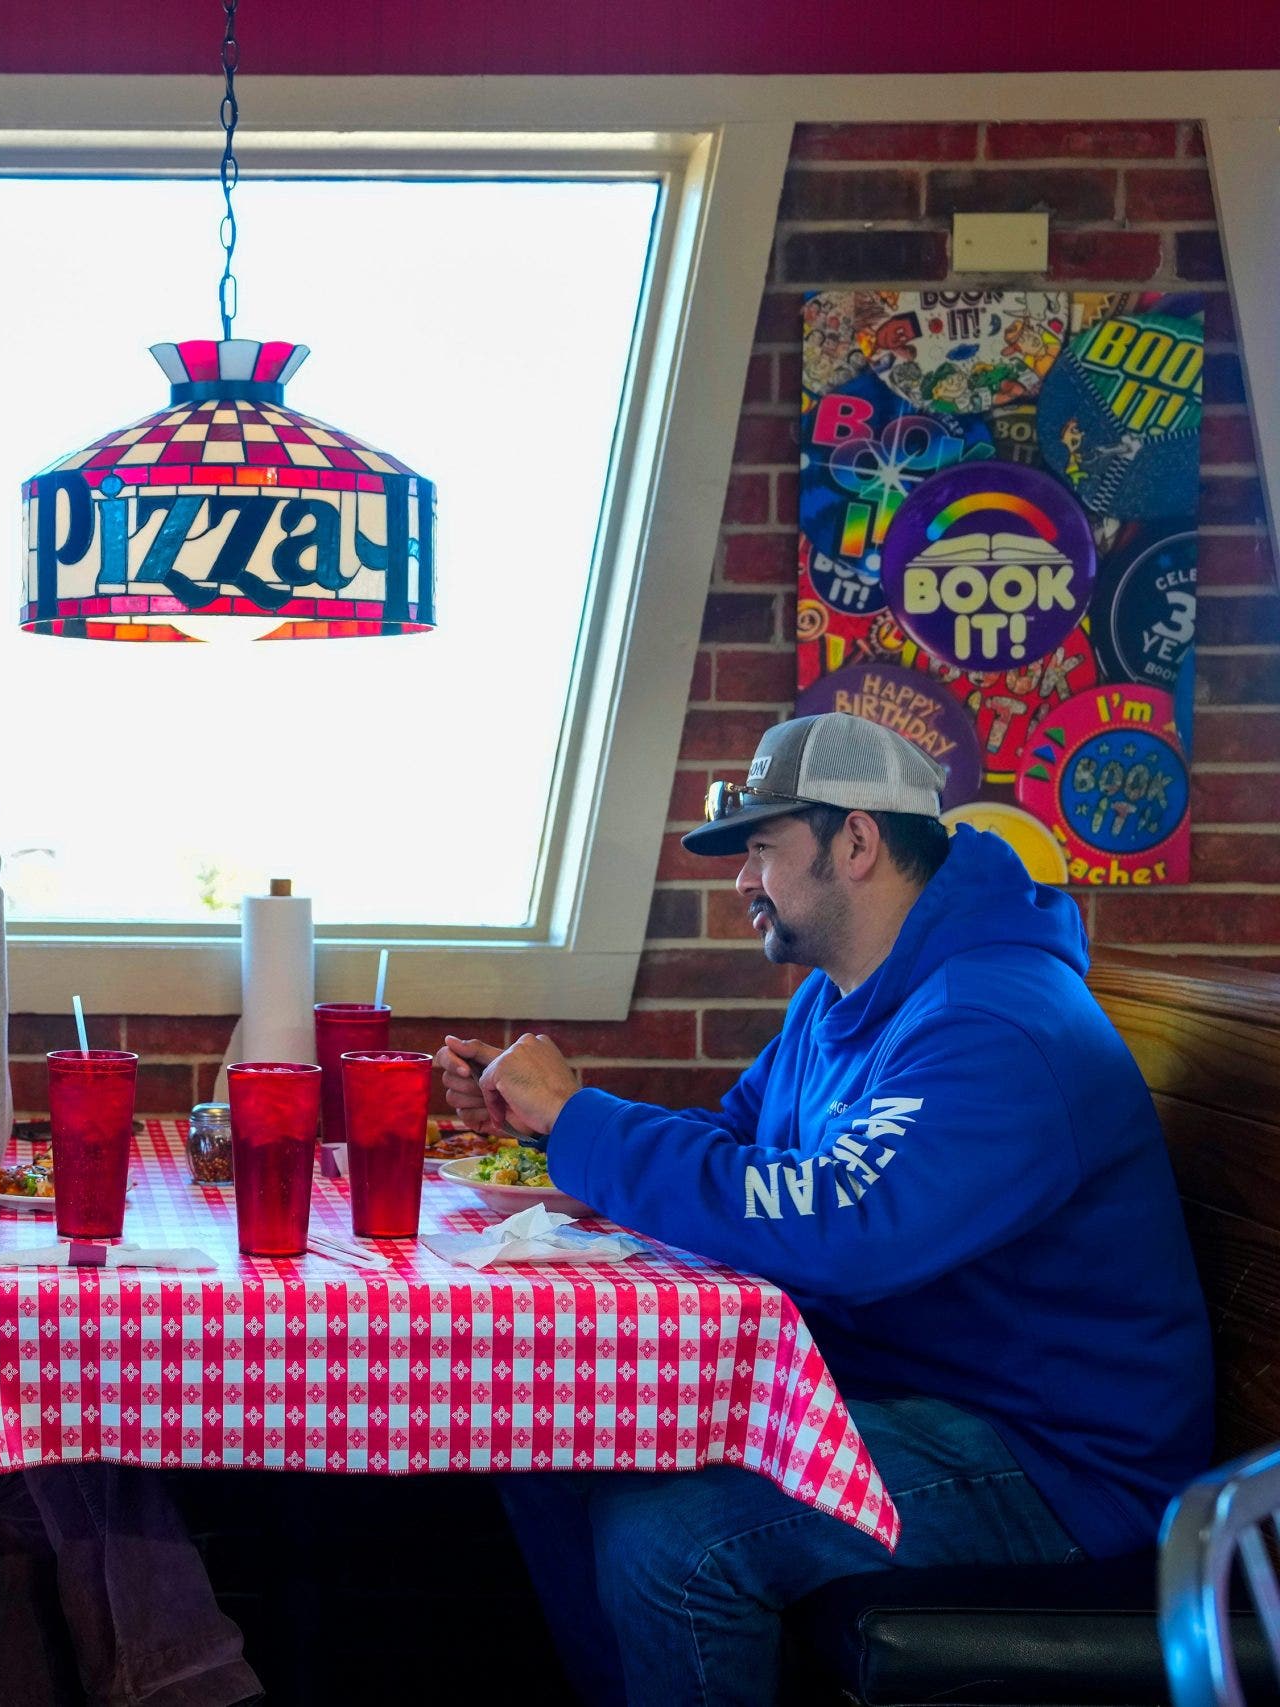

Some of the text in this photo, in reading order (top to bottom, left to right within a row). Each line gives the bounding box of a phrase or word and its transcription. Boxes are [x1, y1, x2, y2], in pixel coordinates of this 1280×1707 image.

[1086, 319, 1204, 396] BOO
[1110, 379, 1187, 436] IT!
[36, 470, 360, 620] Pizza
[828, 577, 870, 610] IT!
[903, 565, 1076, 614] BOOK
[1155, 568, 1197, 591] CELE
[954, 612, 1027, 660] IT!
[1144, 661, 1179, 682] BOO
[862, 674, 942, 719] HAPPY
[1096, 692, 1152, 723] I'm
[834, 690, 958, 758] BIRTHDAY
[1073, 757, 1173, 809] BOOK
